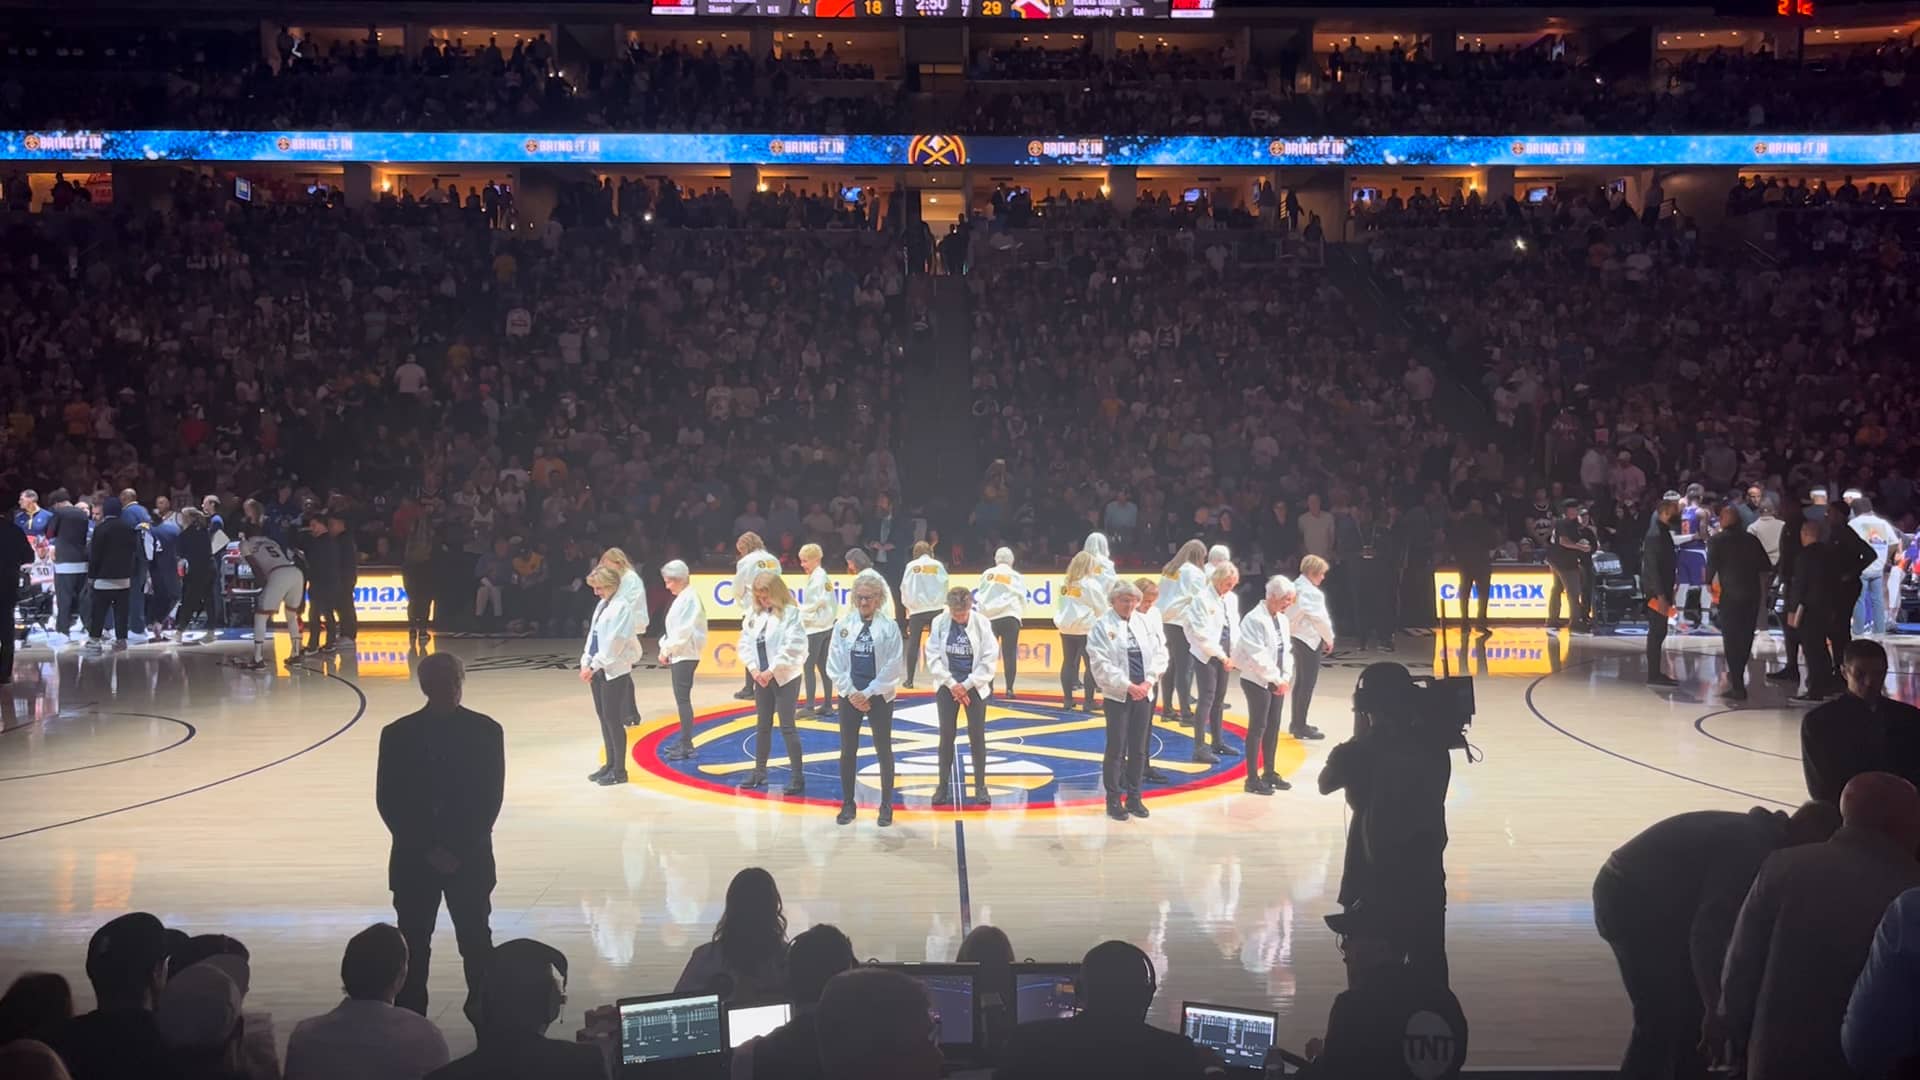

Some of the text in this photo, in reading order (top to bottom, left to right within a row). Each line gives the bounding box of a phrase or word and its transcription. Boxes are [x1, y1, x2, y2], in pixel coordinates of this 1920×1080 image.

[864, 0, 883, 14] 18
[40, 136, 74, 149] BRING
[89, 136, 102, 149] IN
[291, 138, 326, 150] BRING
[341, 138, 353, 150] IN
[540, 140, 573, 152] BRING
[588, 140, 600, 152] IN
[784, 141, 818, 153] BRING
[832, 141, 845, 153] IN
[1043, 142, 1077, 154] BRING
[1091, 142, 1103, 154] IN
[1284, 142, 1317, 154] BRING
[1332, 142, 1344, 154] IN
[1526, 142, 1559, 154] BRING
[1573, 142, 1585, 154] IN
[1768, 142, 1801, 153] BRING
[1817, 142, 1828, 153] IN
[1404, 1034, 1456, 1061] TNT
